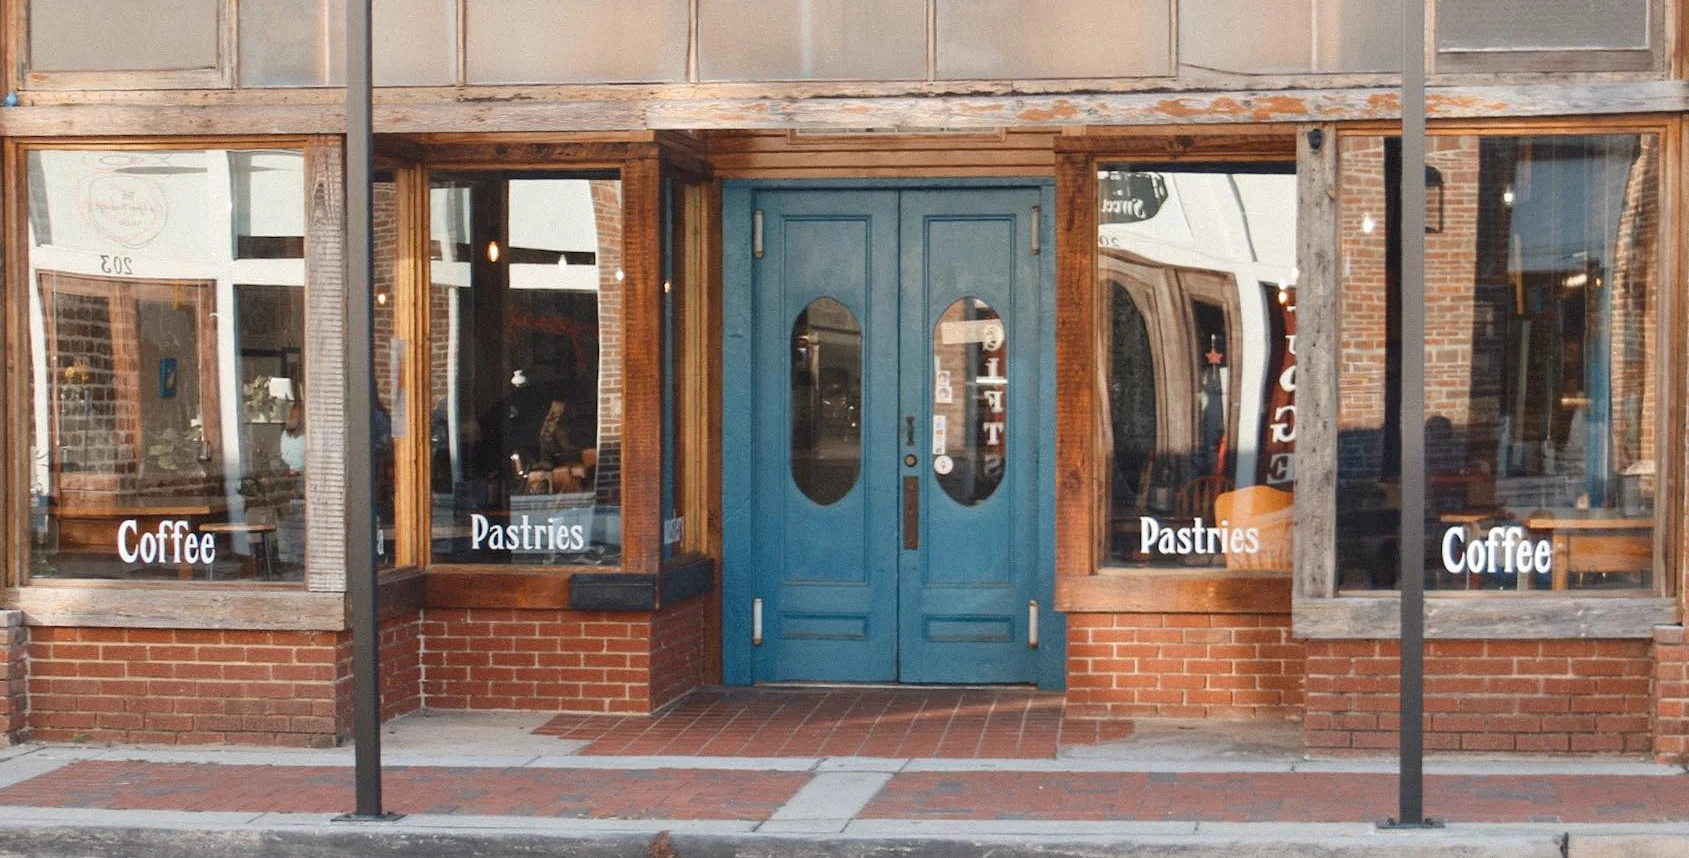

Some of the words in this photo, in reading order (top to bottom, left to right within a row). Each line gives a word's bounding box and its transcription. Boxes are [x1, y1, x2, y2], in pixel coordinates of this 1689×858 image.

[118, 519, 216, 564] Coffee
[470, 513, 584, 550] Pastries
[1139, 516, 1260, 554] Pastries
[1441, 526, 1552, 573] Coffee
